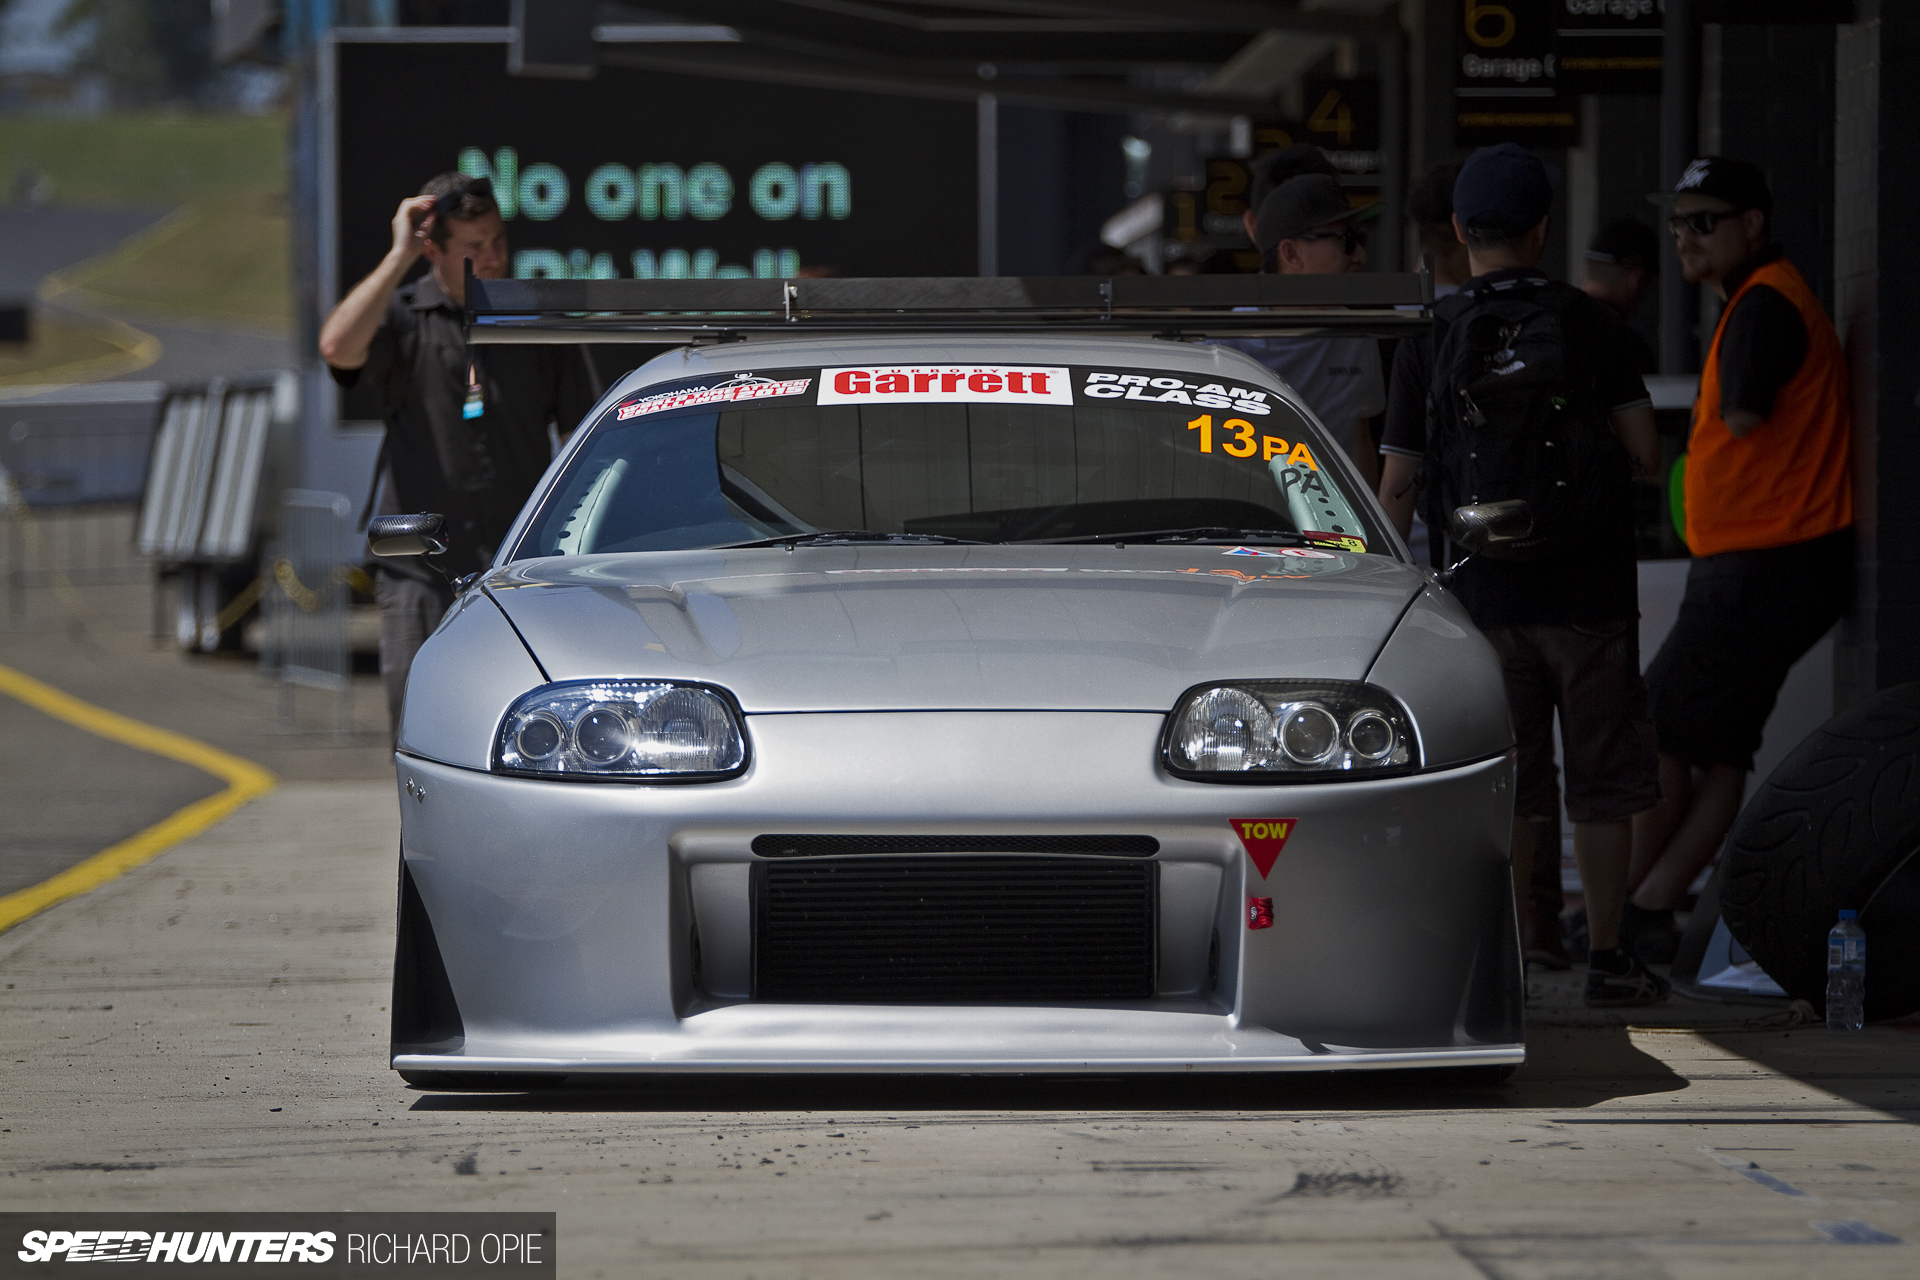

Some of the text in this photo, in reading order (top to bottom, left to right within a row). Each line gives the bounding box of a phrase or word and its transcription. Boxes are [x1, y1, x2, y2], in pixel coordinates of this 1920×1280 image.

[1464, 0, 1516, 48] 6
[1462, 53, 1543, 83] Garage
[1306, 89, 1356, 146] 4
[458, 146, 851, 221] No one on
[638, 385, 708, 403] YOKOHAMA
[733, 386, 804, 400] 2015
[834, 370, 1051, 395] Garrett
[1086, 372, 1267, 402] PRO-AM
[1084, 383, 1272, 415] CLASS
[1241, 822, 1288, 839] TOW
